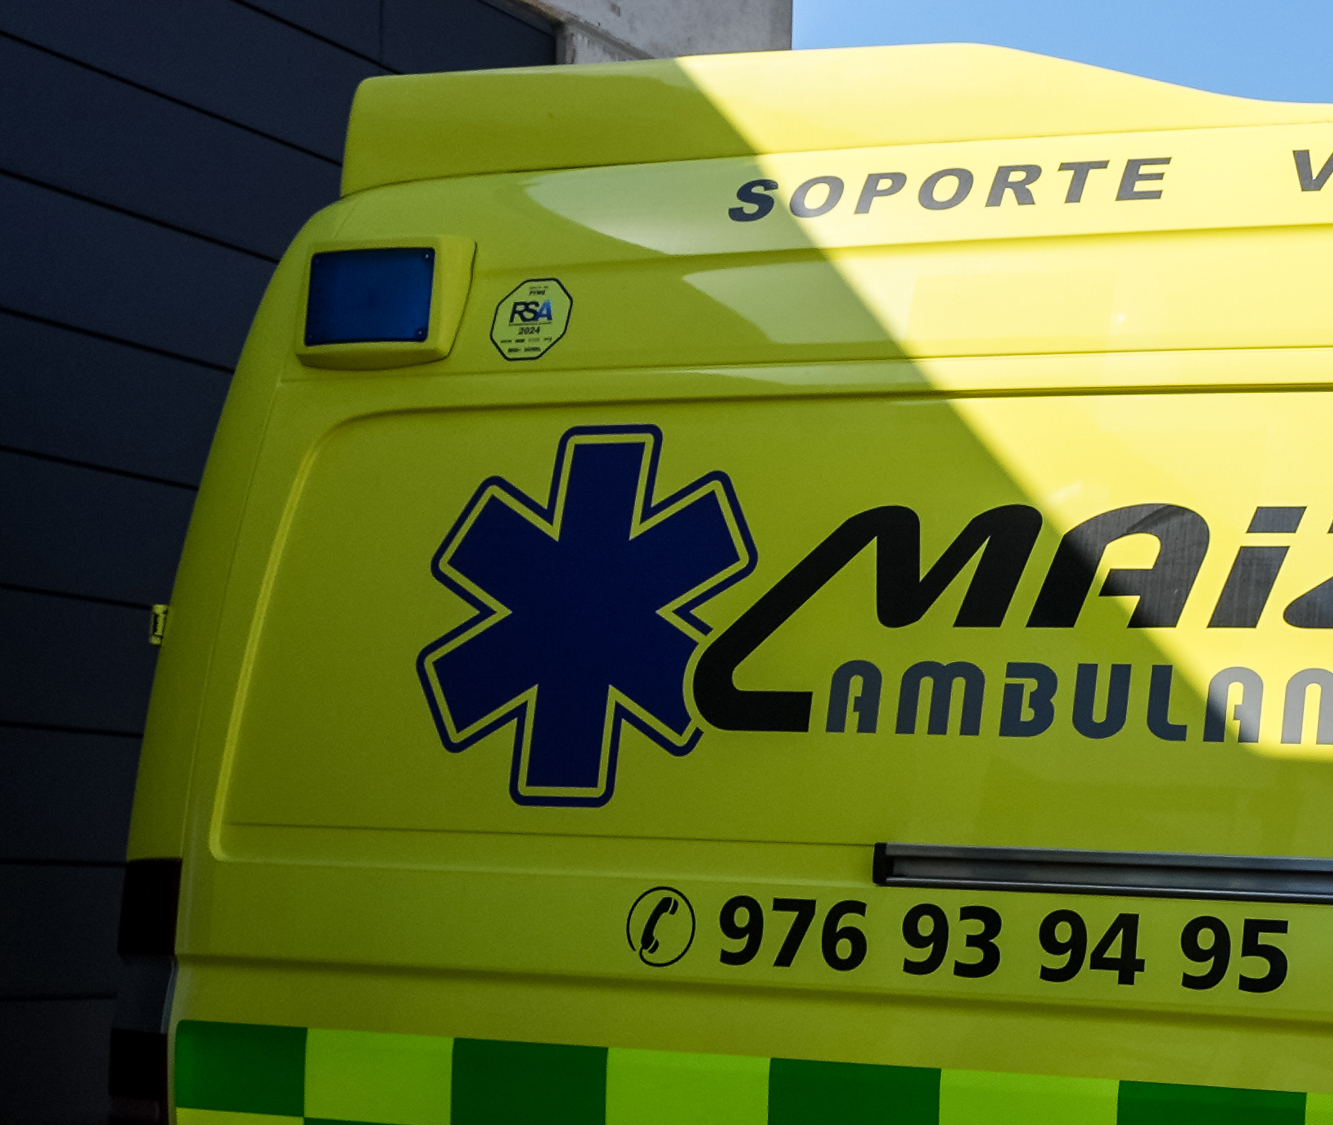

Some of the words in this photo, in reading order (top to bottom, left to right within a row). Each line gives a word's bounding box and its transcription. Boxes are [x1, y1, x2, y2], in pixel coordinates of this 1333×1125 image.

[729, 155, 1173, 222] SOPORTE
[509, 298, 553, 323] RSA
[518, 326, 540, 335] 2024
[718, 895, 869, 971] 976
[902, 903, 1003, 978] 93
[1037, 908, 1146, 986] 94
[1179, 915, 1290, 993] 95
